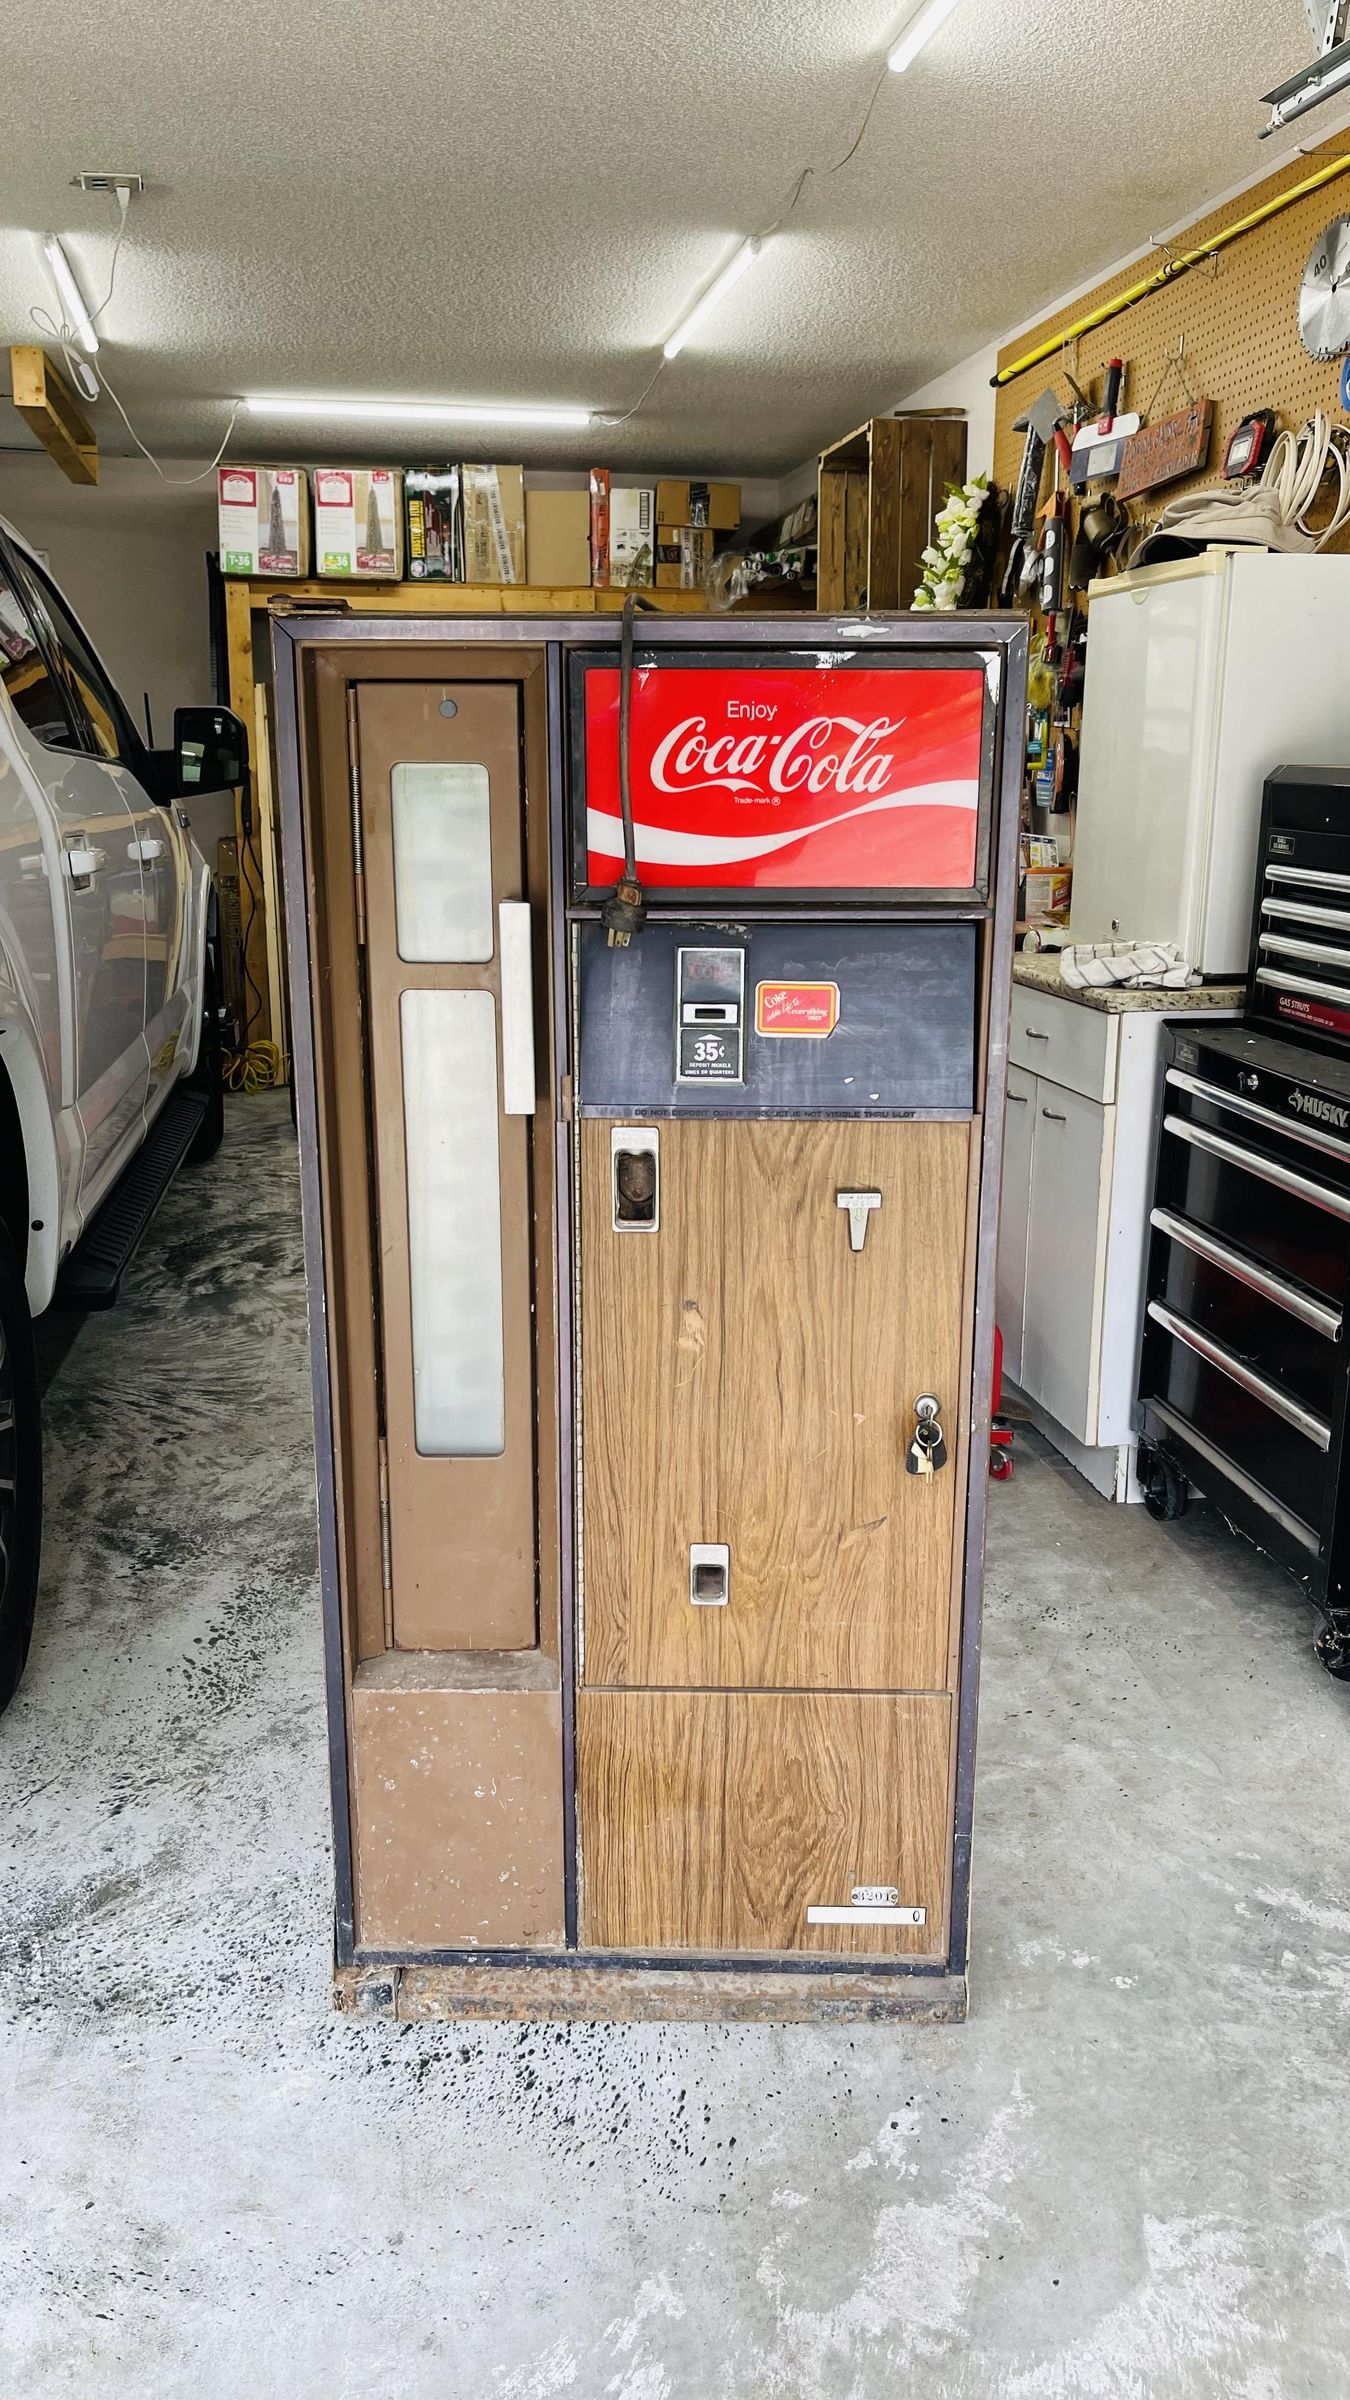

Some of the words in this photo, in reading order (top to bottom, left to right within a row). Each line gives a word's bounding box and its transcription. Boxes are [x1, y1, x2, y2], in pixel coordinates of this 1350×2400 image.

[1314, 255, 1327, 277] 40
[727, 700, 777, 720] Enjoy
[650, 715, 907, 794] Coca-Cola
[764, 991, 788, 1009] Coke
[1279, 997, 1291, 1007] GAS
[1291, 1000, 1311, 1012] STRUTS
[791, 1008, 829, 1018] everything
[693, 1042, 726, 1062] 35¢
[634, 1109, 647, 1117] DO
[650, 1109, 669, 1117] NOT
[672, 1109, 709, 1117] DEPOSIT
[1303, 1095, 1349, 1128] HUSKY
